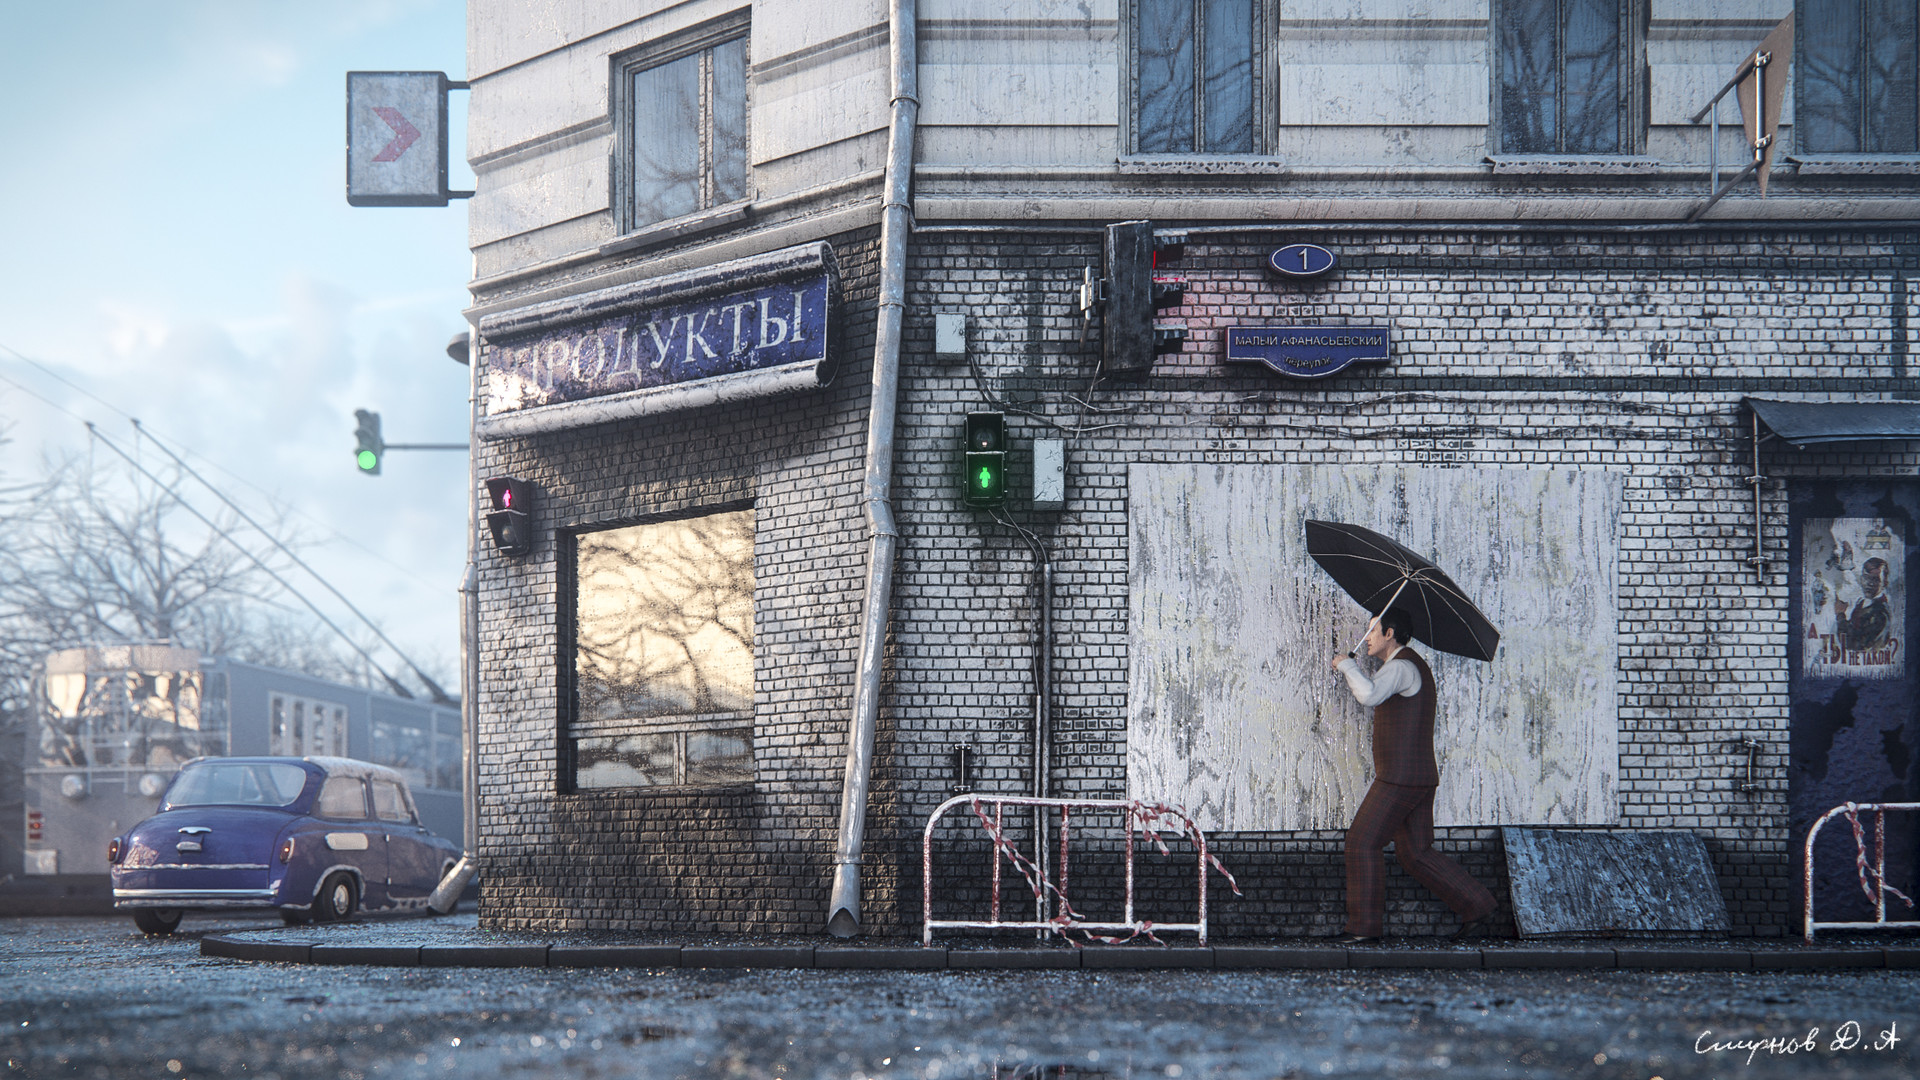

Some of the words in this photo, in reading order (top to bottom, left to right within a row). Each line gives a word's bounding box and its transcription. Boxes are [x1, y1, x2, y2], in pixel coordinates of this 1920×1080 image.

[1298, 247, 1308, 270] 1
[1235, 336, 1278, 347] МАЛЫЙ
[1281, 336, 1382, 347] АФАНАСЬЕВСКИЙ
[1807, 622, 1818, 639] А
[1820, 633, 1847, 664] ТЫ
[1848, 650, 1860, 666] НЕ
